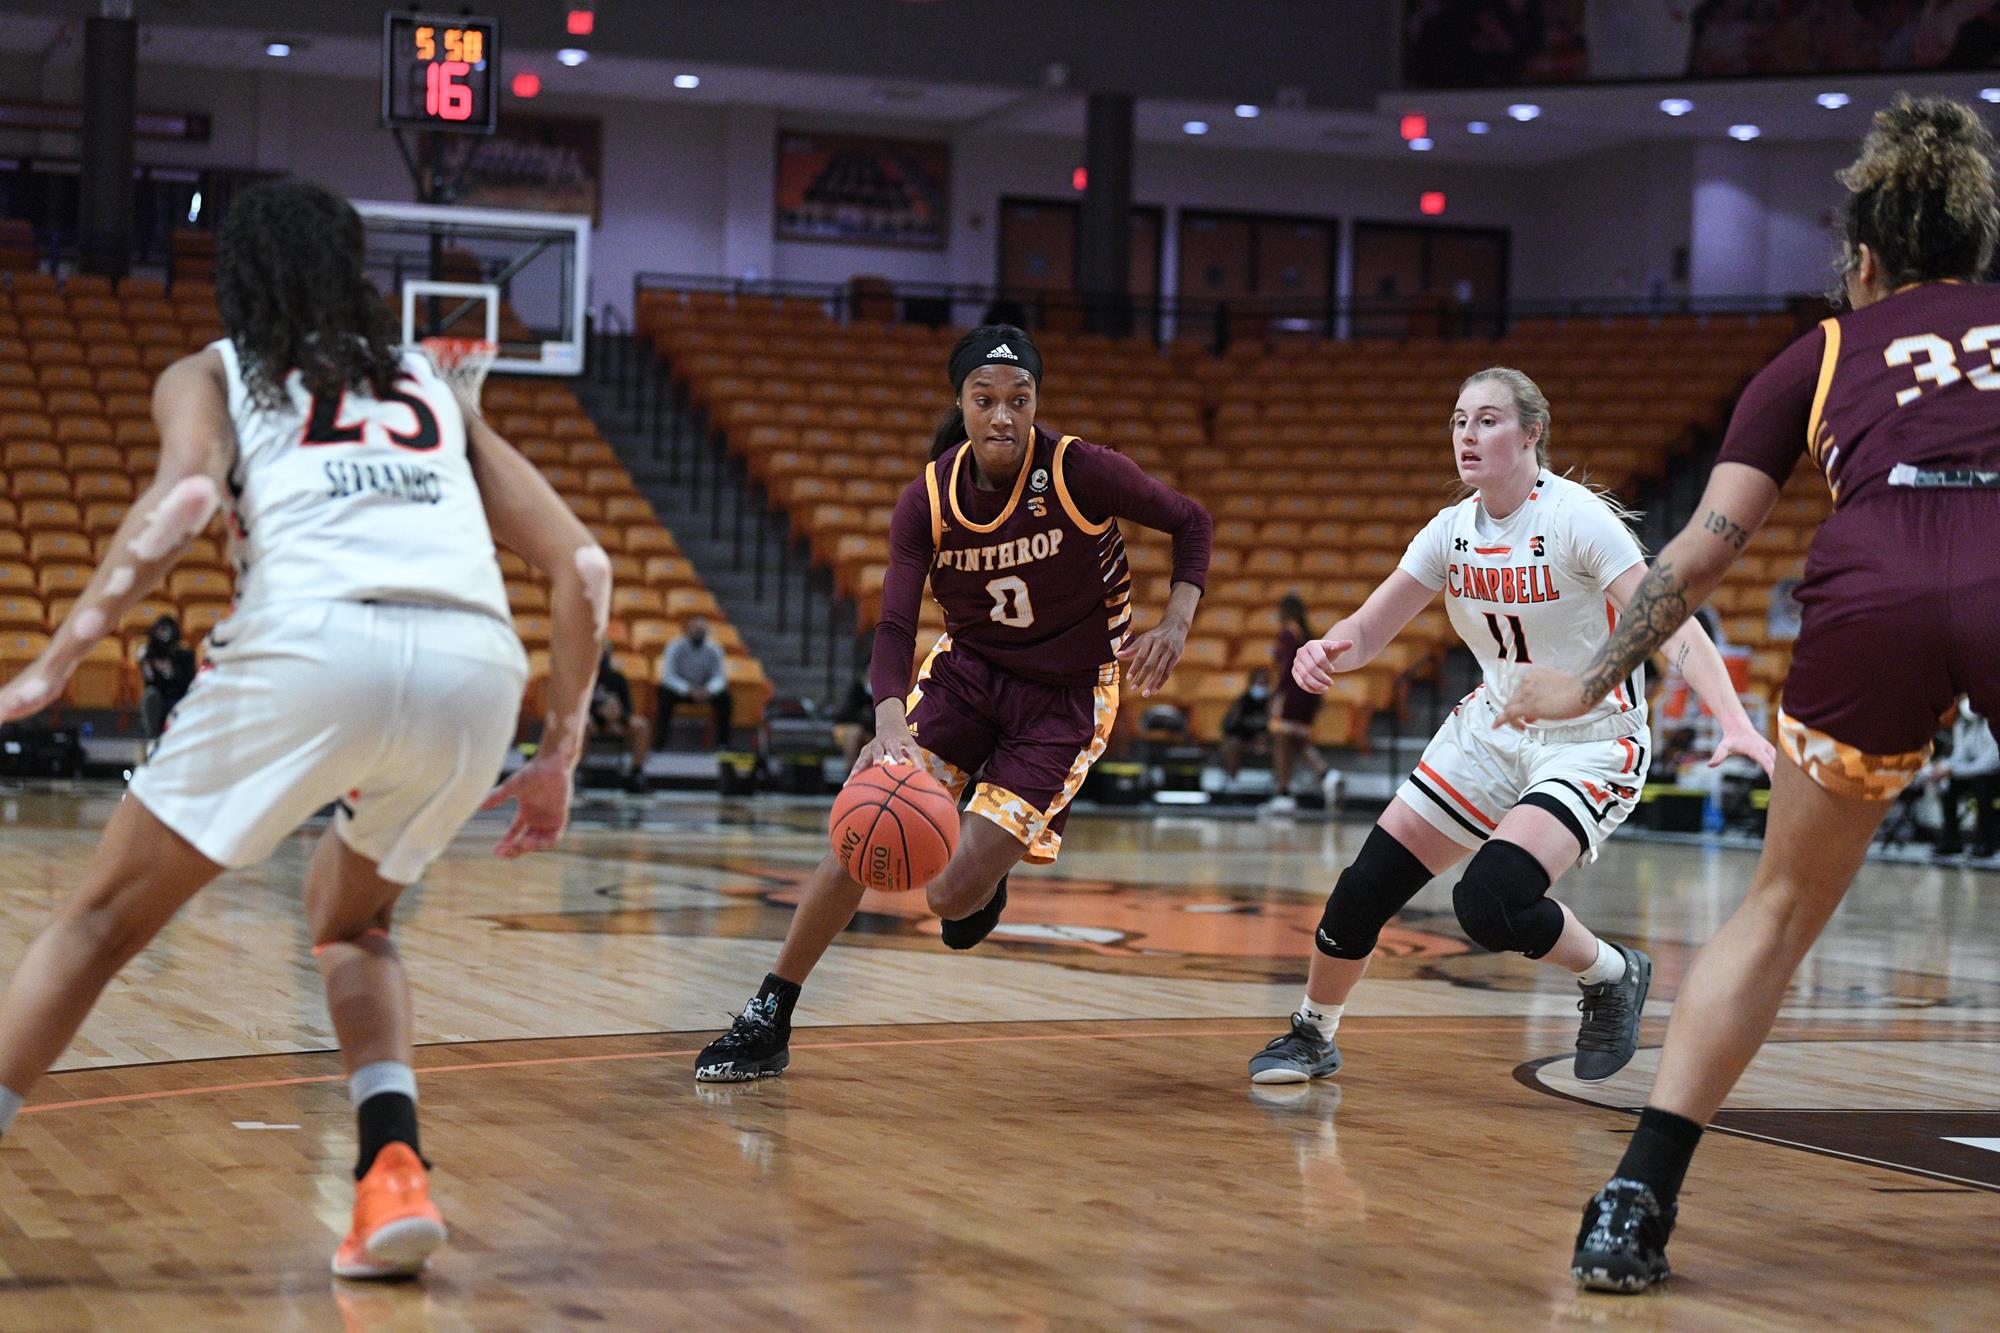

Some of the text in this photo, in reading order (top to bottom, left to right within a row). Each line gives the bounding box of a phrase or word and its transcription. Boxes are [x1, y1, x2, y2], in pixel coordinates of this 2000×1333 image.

[426, 61, 472, 120] 16
[934, 528, 1063, 571] WINTHROP
[985, 575, 1035, 628] 0
[1448, 563, 1560, 604] CAMPBELL
[1481, 611, 1533, 664] 11
[872, 846, 888, 886] 1000
